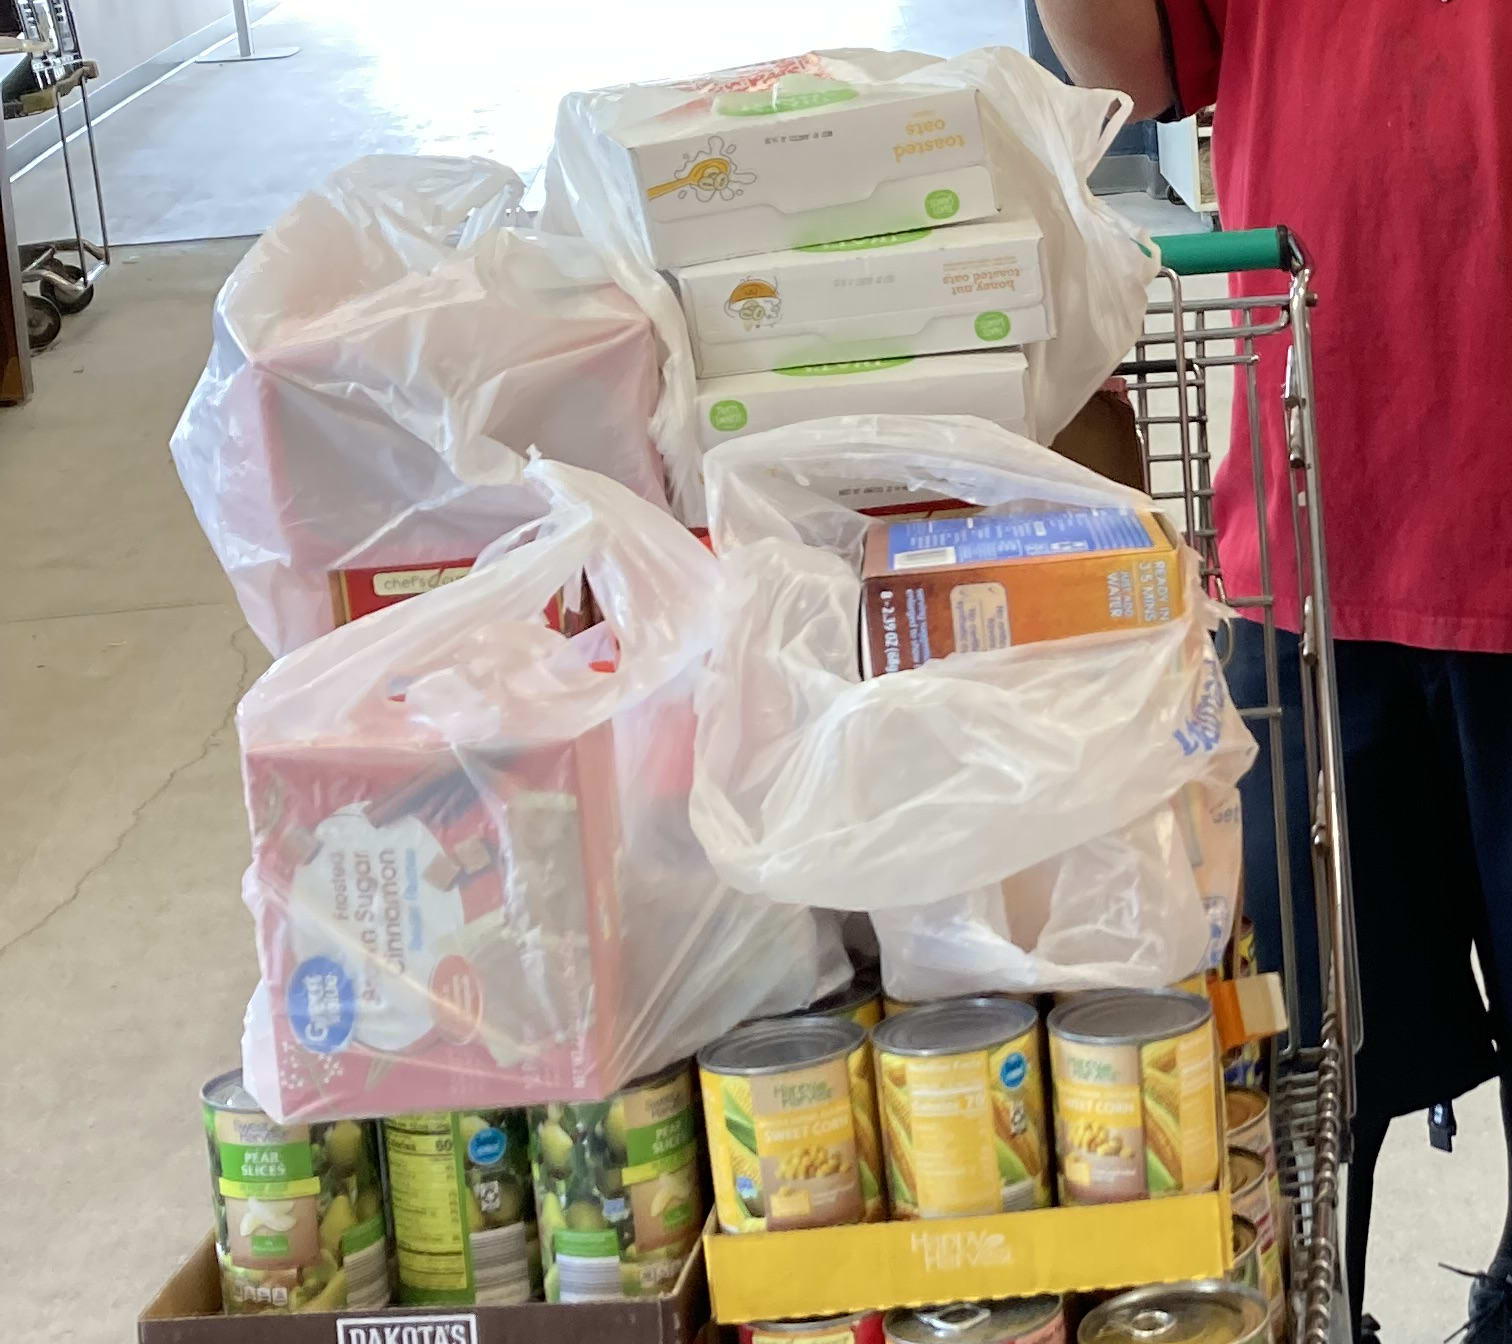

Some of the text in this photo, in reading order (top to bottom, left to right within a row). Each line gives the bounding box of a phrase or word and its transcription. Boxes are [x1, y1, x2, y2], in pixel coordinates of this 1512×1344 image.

[905, 119, 946, 135] oats
[892, 134, 966, 163] toasted
[951, 278, 1017, 296] honey nut
[1107, 572, 1122, 617] WATER
[1154, 560, 1168, 602] READY
[331, 850, 349, 920] Frosted
[353, 851, 378, 921] Sugar
[241, 1164, 286, 1177] SLICES
